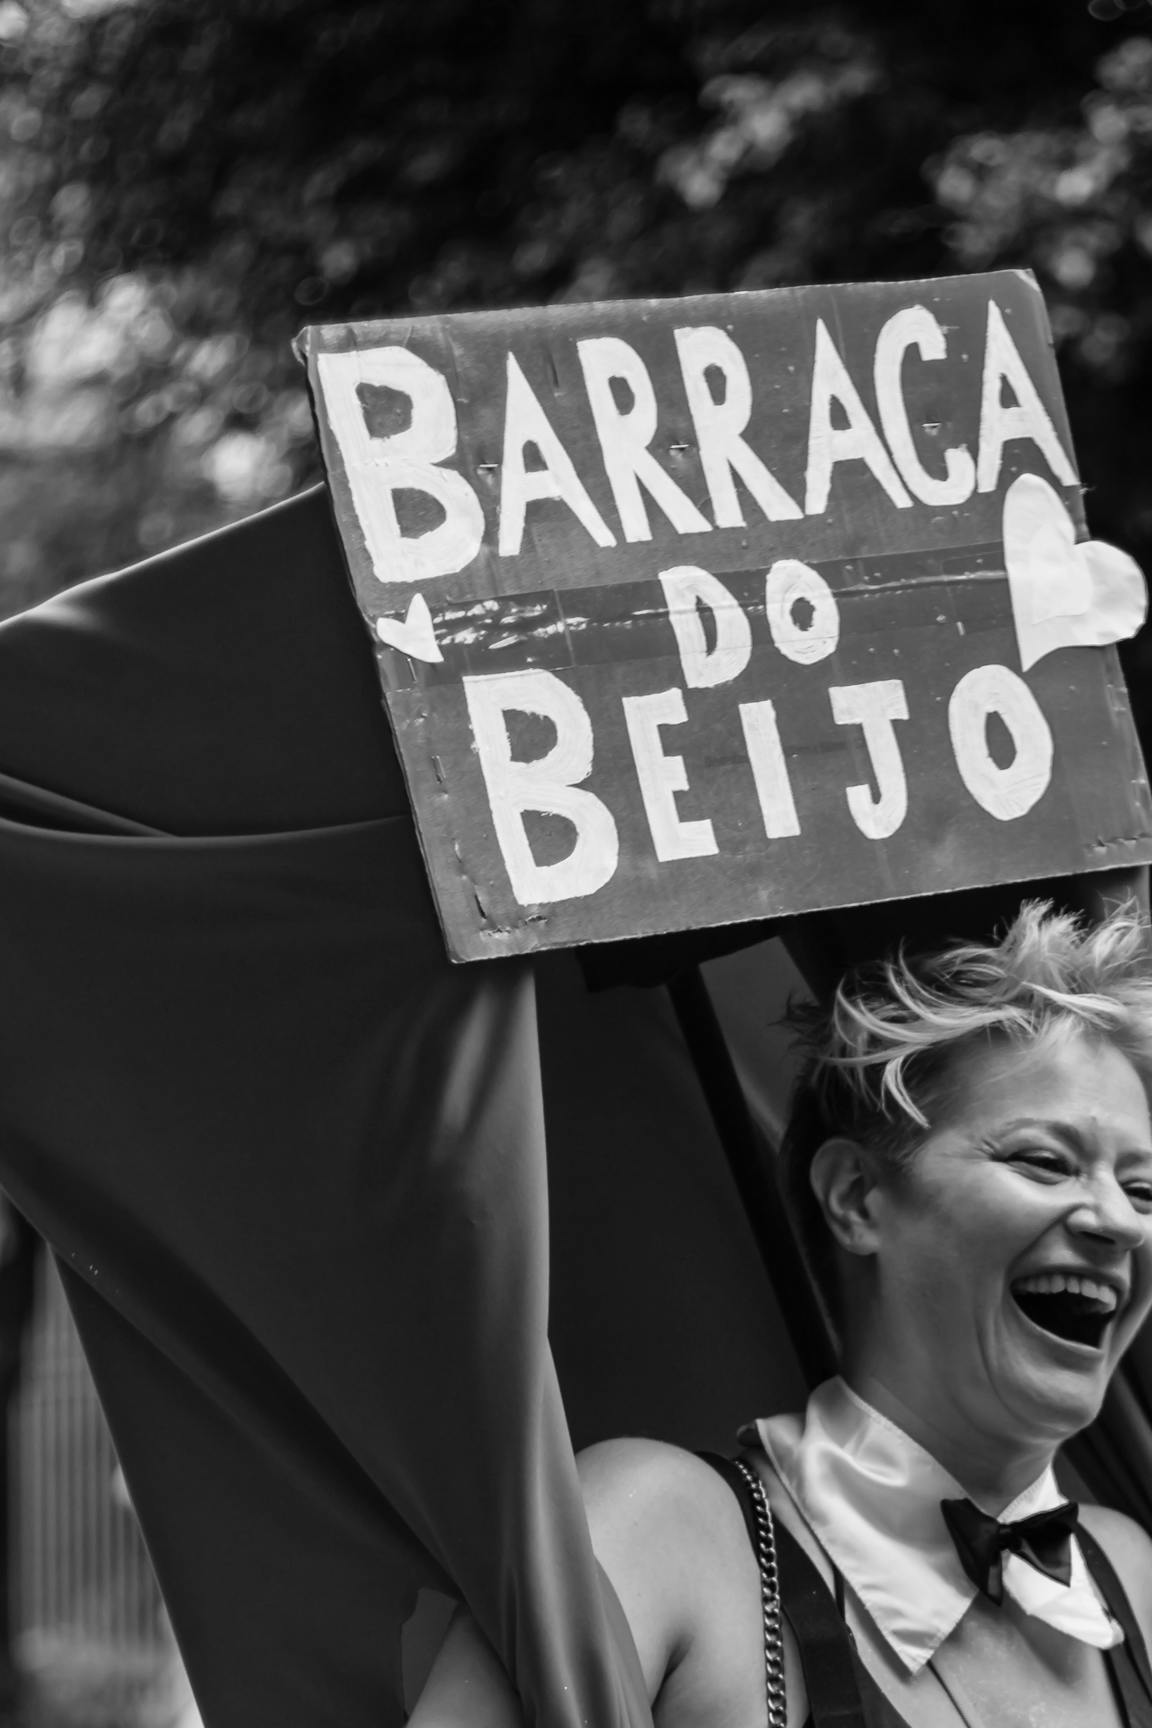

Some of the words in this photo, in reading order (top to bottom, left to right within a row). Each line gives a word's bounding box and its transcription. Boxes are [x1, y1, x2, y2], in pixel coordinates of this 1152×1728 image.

[318, 301, 1078, 583] BARRACA
[659, 559, 838, 688] DO
[463, 665, 1052, 906] BEIJO
